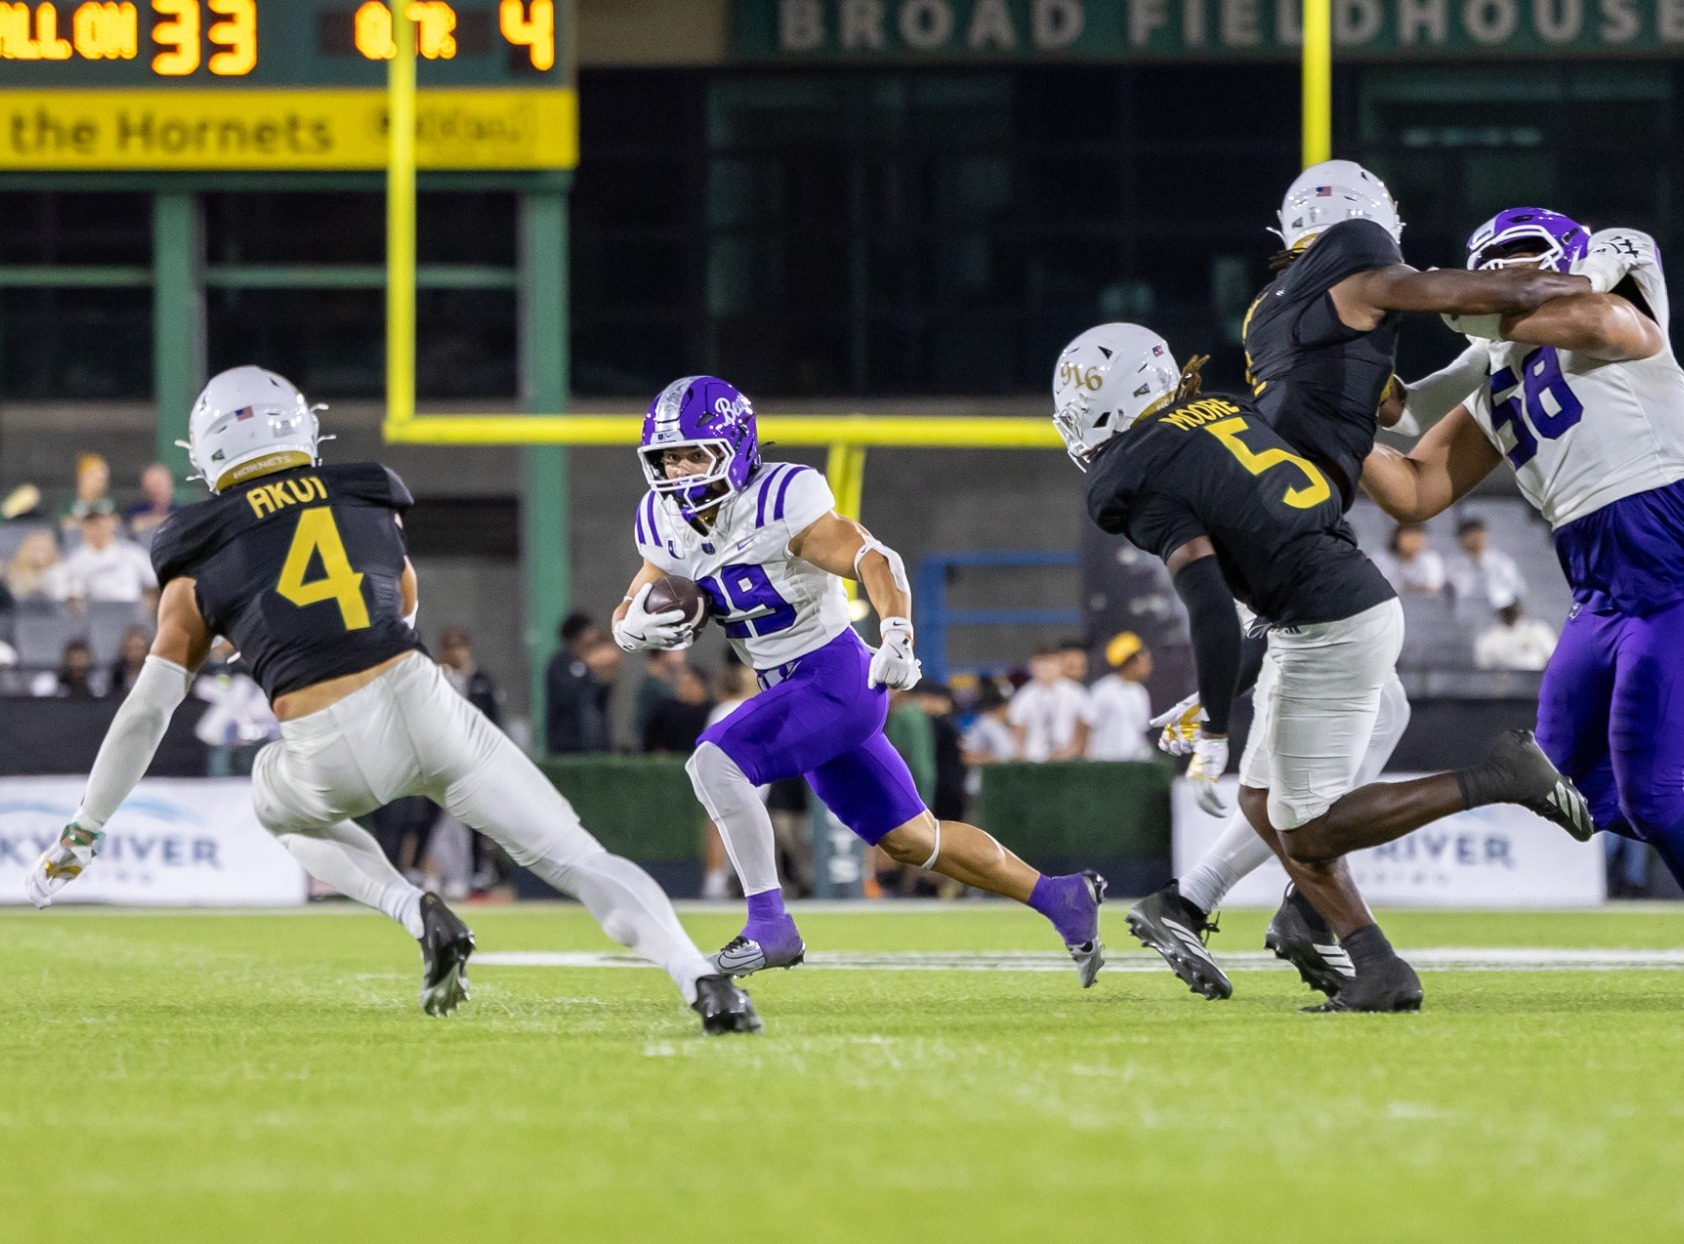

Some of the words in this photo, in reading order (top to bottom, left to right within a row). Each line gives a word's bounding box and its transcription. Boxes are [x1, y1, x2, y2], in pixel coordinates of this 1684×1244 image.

[151, 0, 257, 76] 33
[499, 0, 555, 71] 4
[778, 0, 1084, 50] BROAD
[9, 109, 99, 153] the
[116, 109, 334, 155] Hornets
[1060, 361, 1103, 391] 916
[1158, 398, 1240, 431] MOORE
[1488, 346, 1584, 471] 58
[232, 454, 293, 479] HORNETS
[1203, 416, 1331, 509] 5
[246, 475, 328, 520] AKUI
[275, 506, 371, 631] 4
[95, 835, 221, 869] IVER
